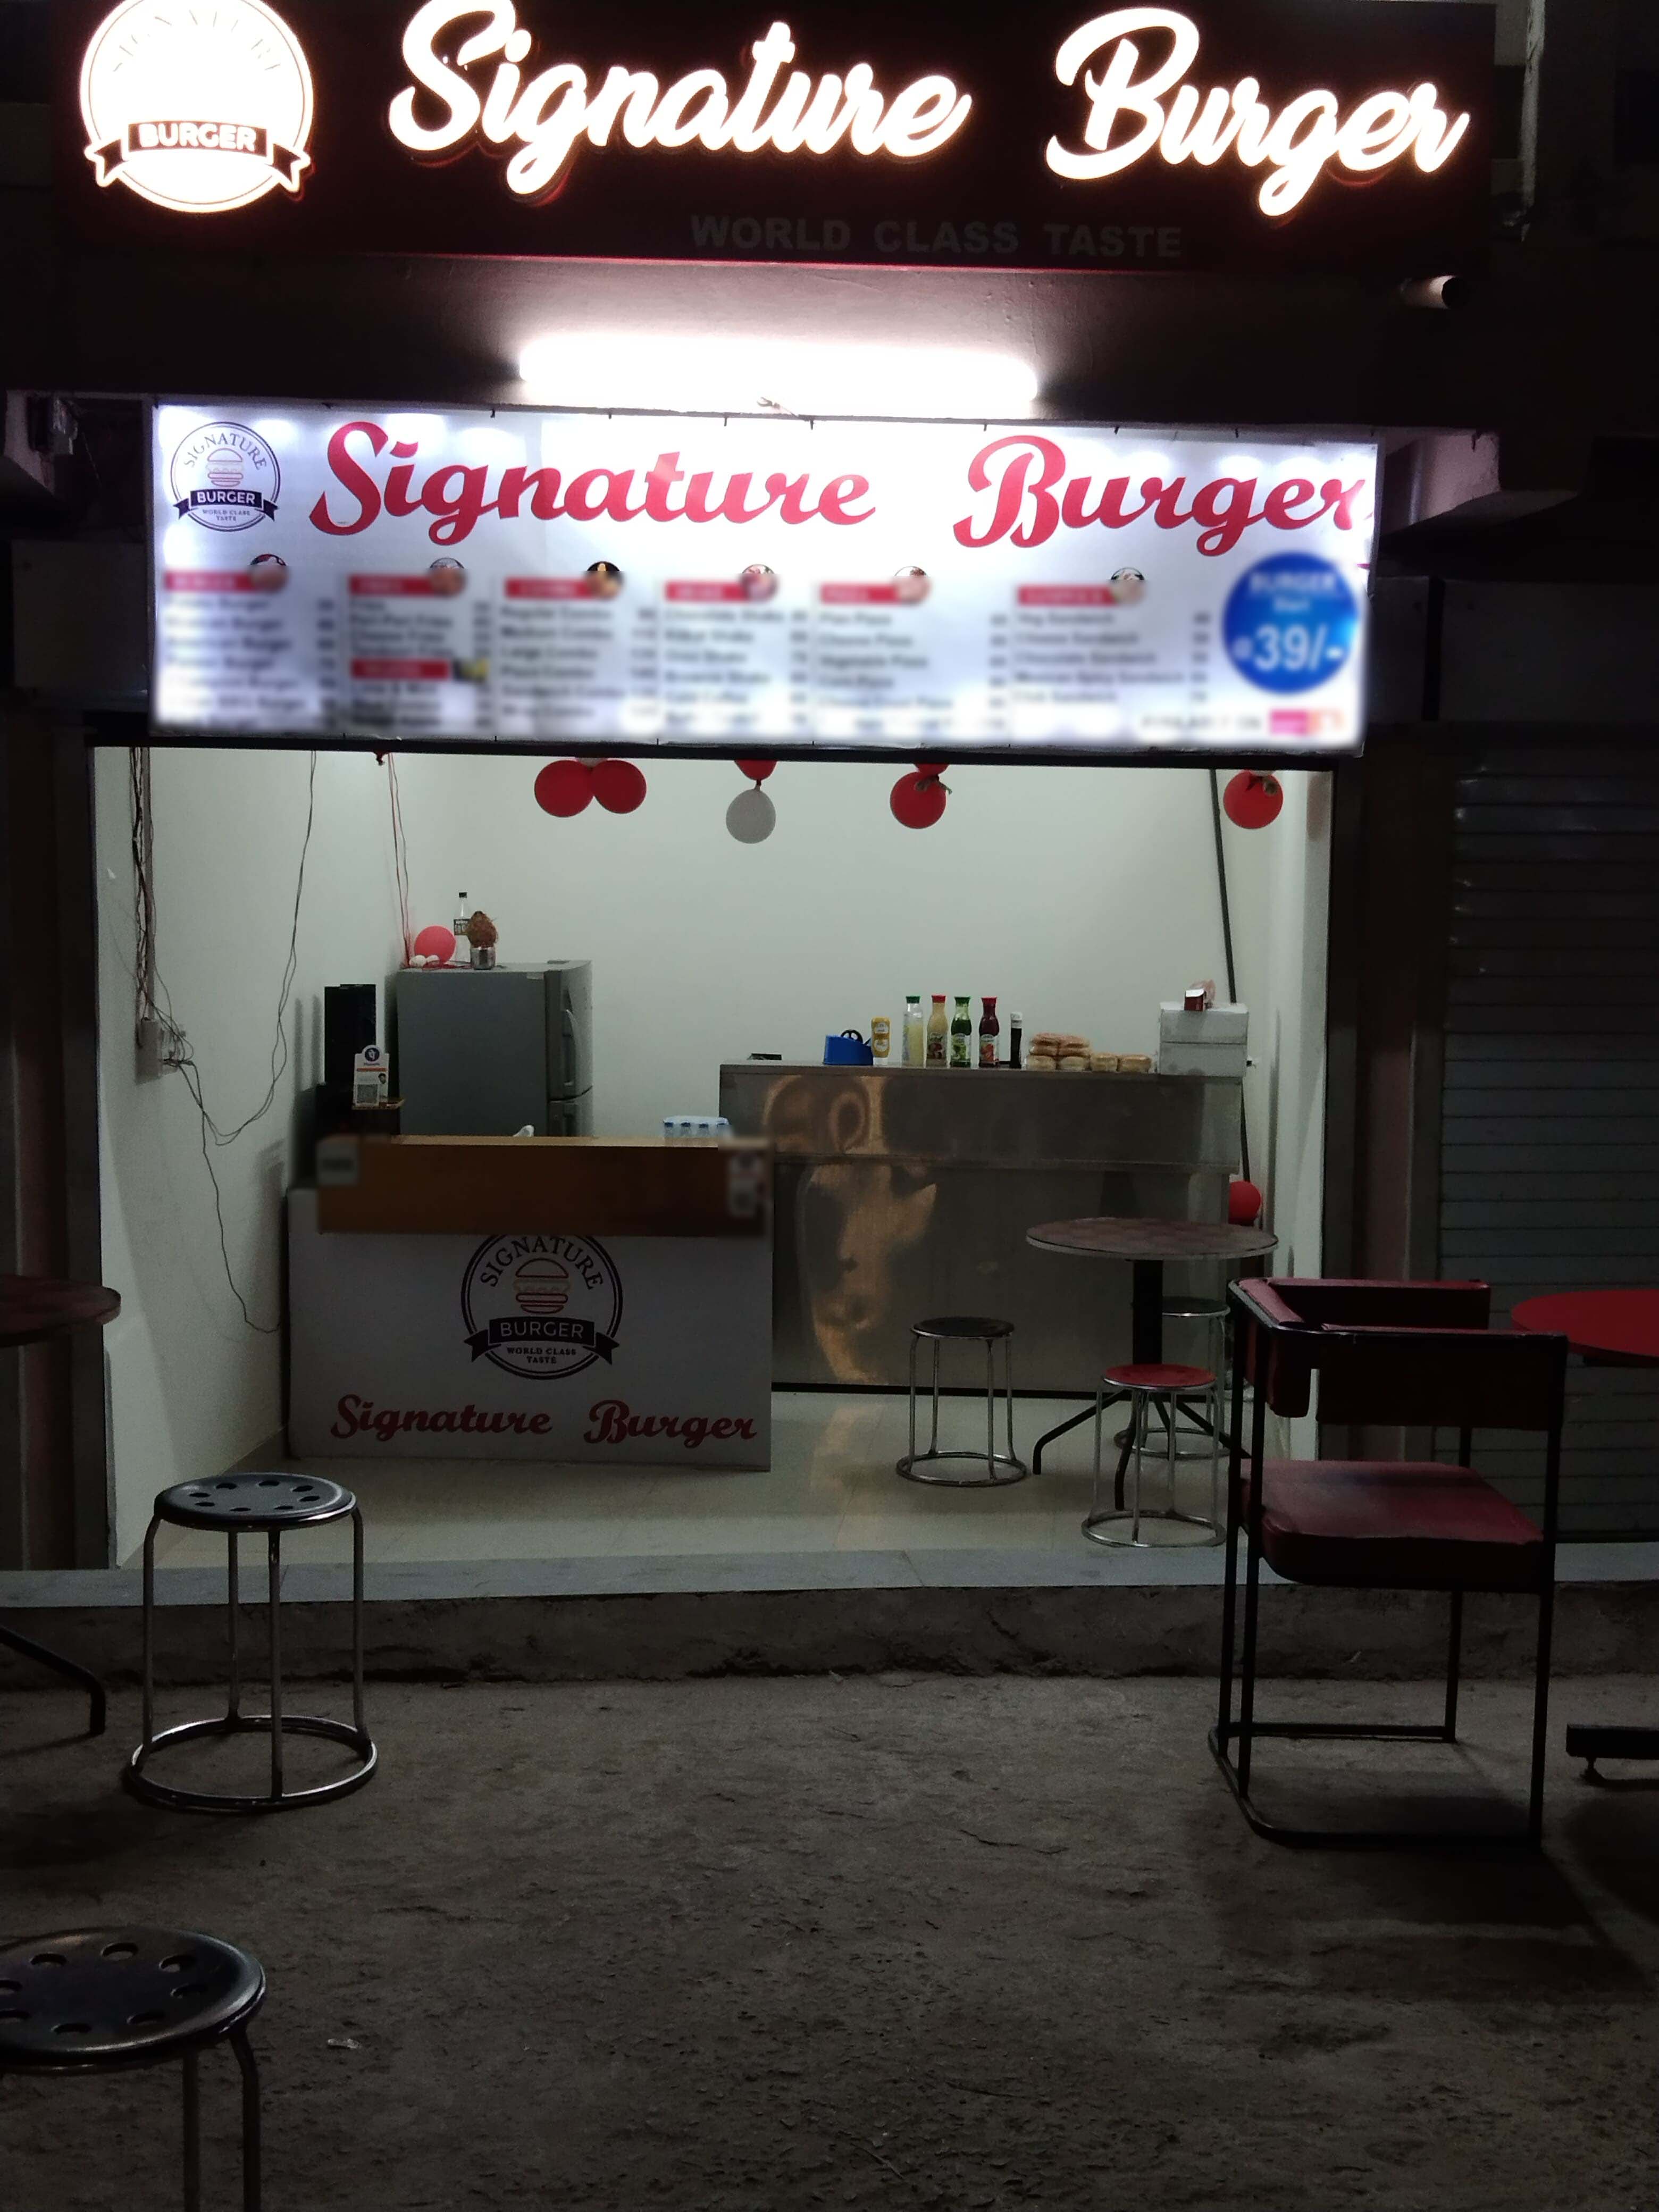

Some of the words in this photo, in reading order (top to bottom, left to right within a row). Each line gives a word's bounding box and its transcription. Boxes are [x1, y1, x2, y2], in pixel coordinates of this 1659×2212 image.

[389, 0, 971, 195] Signature
[1045, 7, 1470, 216] Burger
[139, 123, 256, 152] BURGER
[690, 214, 851, 252] WORLD
[874, 219, 1019, 255] CLASS
[1043, 222, 1183, 258] TASTE
[183, 432, 267, 471] SIGNATURE
[196, 491, 256, 504] BURGER
[309, 420, 876, 546] Signature
[953, 434, 1373, 557] Burger
[480, 1235, 604, 1291] SIGNATURE
[500, 1321, 584, 1340] BURGER
[507, 1347, 543, 1355] WORLD
[545, 1347, 577, 1356] CLASS
[330, 1393, 553, 1442] Signature
[583, 1398, 759, 1449] Burger
